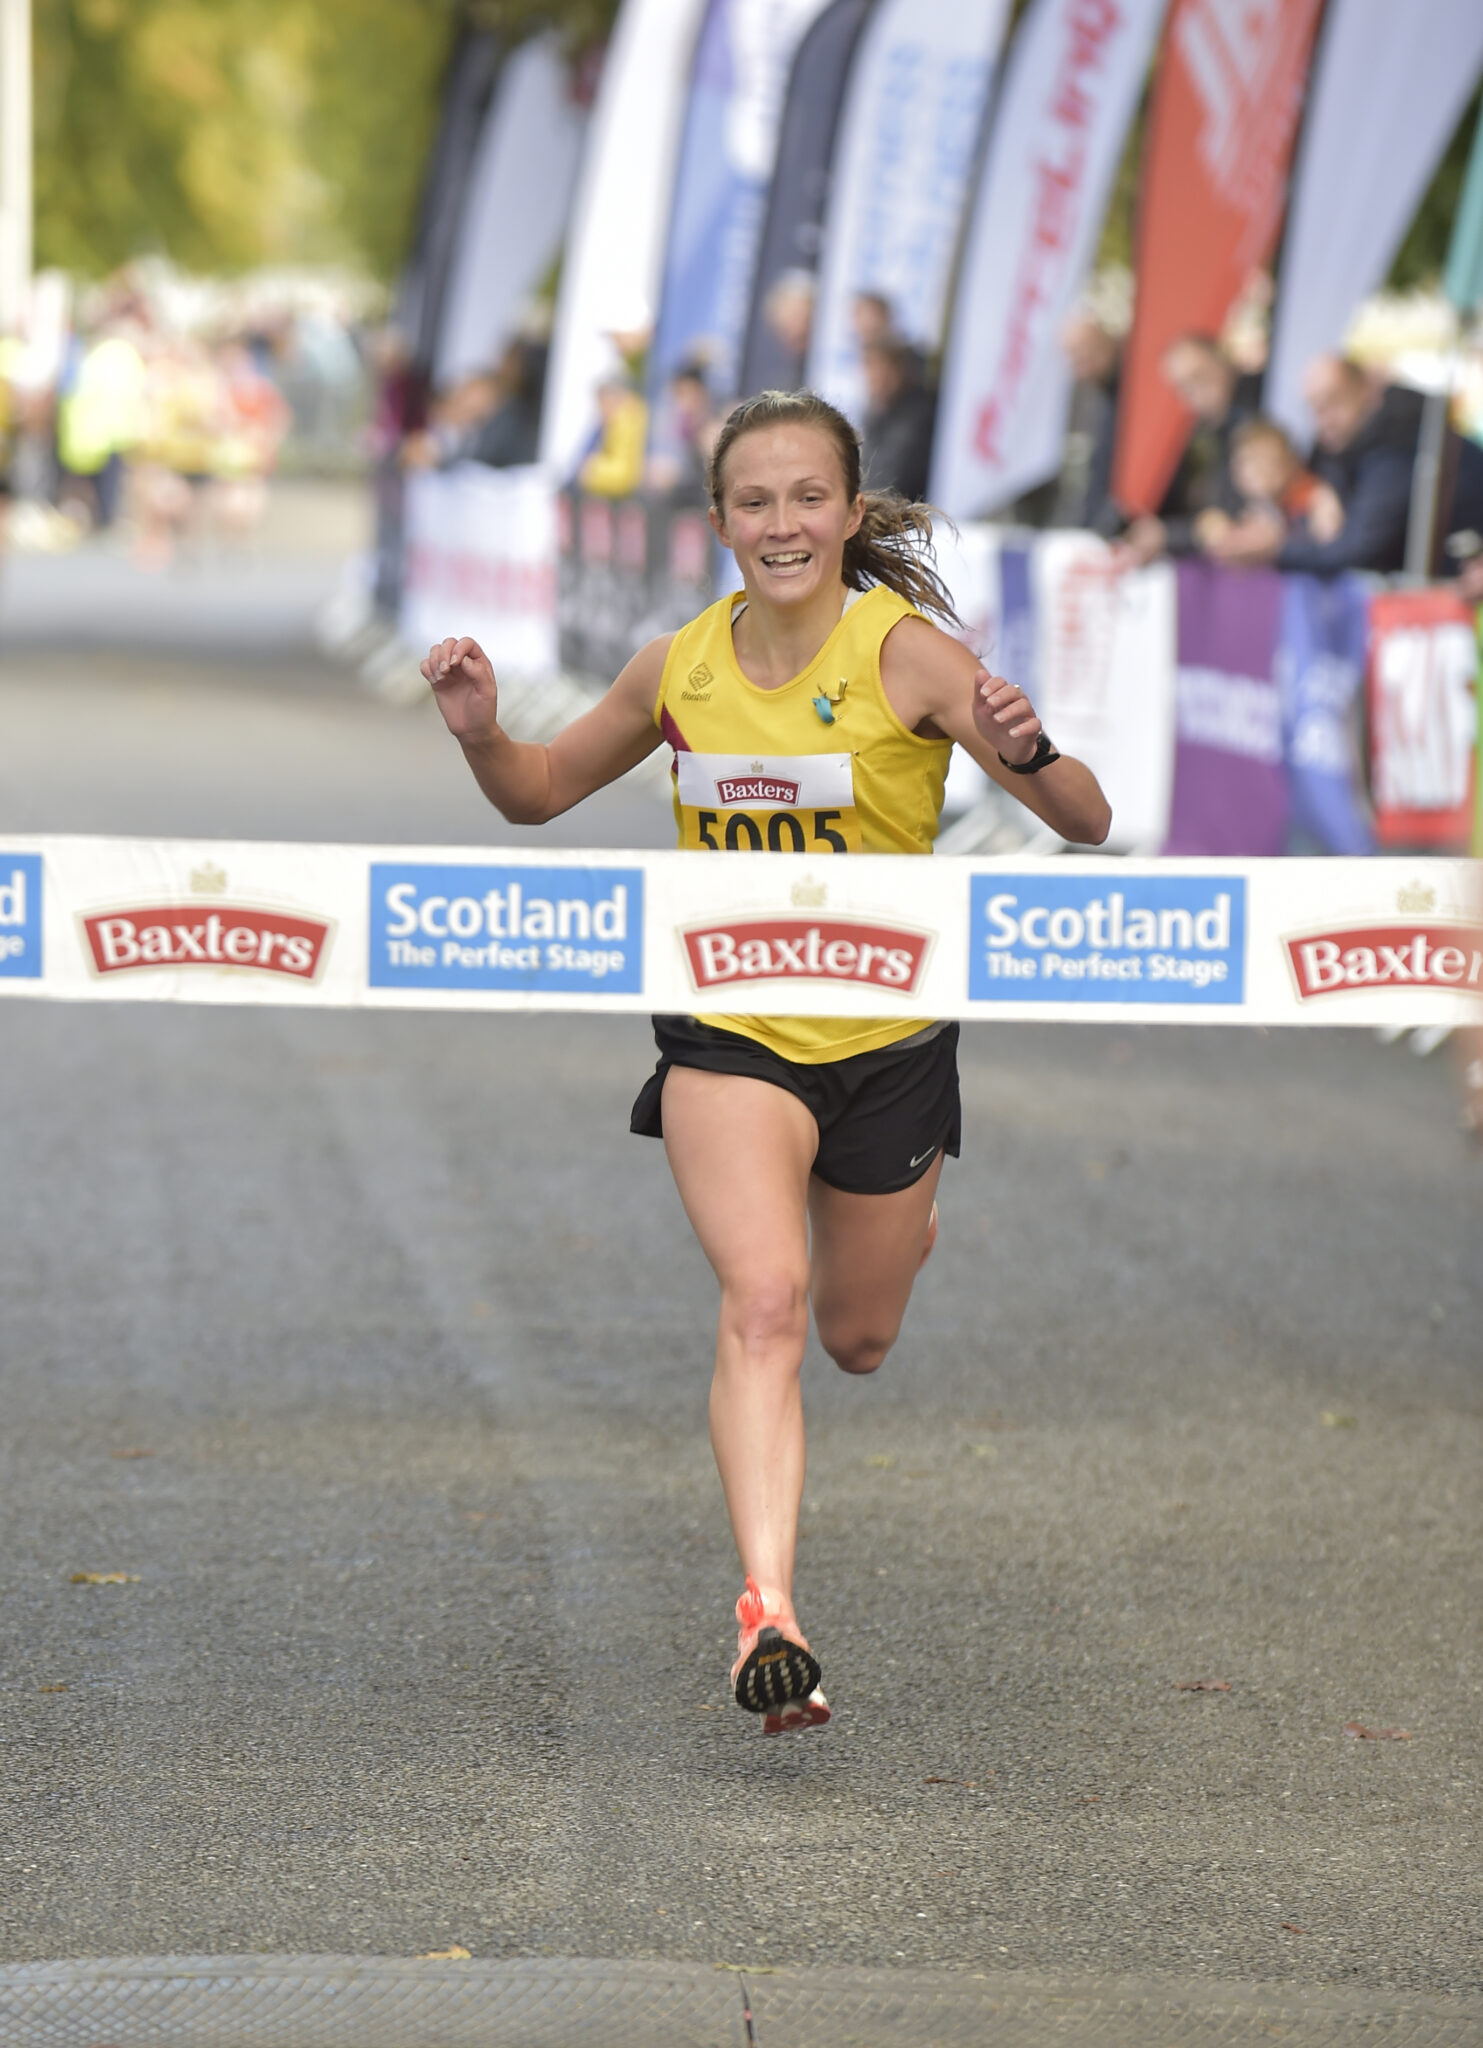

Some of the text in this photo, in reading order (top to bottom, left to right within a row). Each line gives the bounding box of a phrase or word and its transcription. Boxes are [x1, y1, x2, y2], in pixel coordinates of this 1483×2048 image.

[722, 780, 794, 801] Baxters
[698, 811, 848, 851] 5005
[386, 882, 628, 941] Scotland
[986, 892, 1231, 949] Scotland
[97, 914, 314, 971] Baxters
[387, 940, 626, 978] The Perfect Stage
[697, 927, 914, 984] Baxters
[987, 951, 1228, 988] The Perfect Stage
